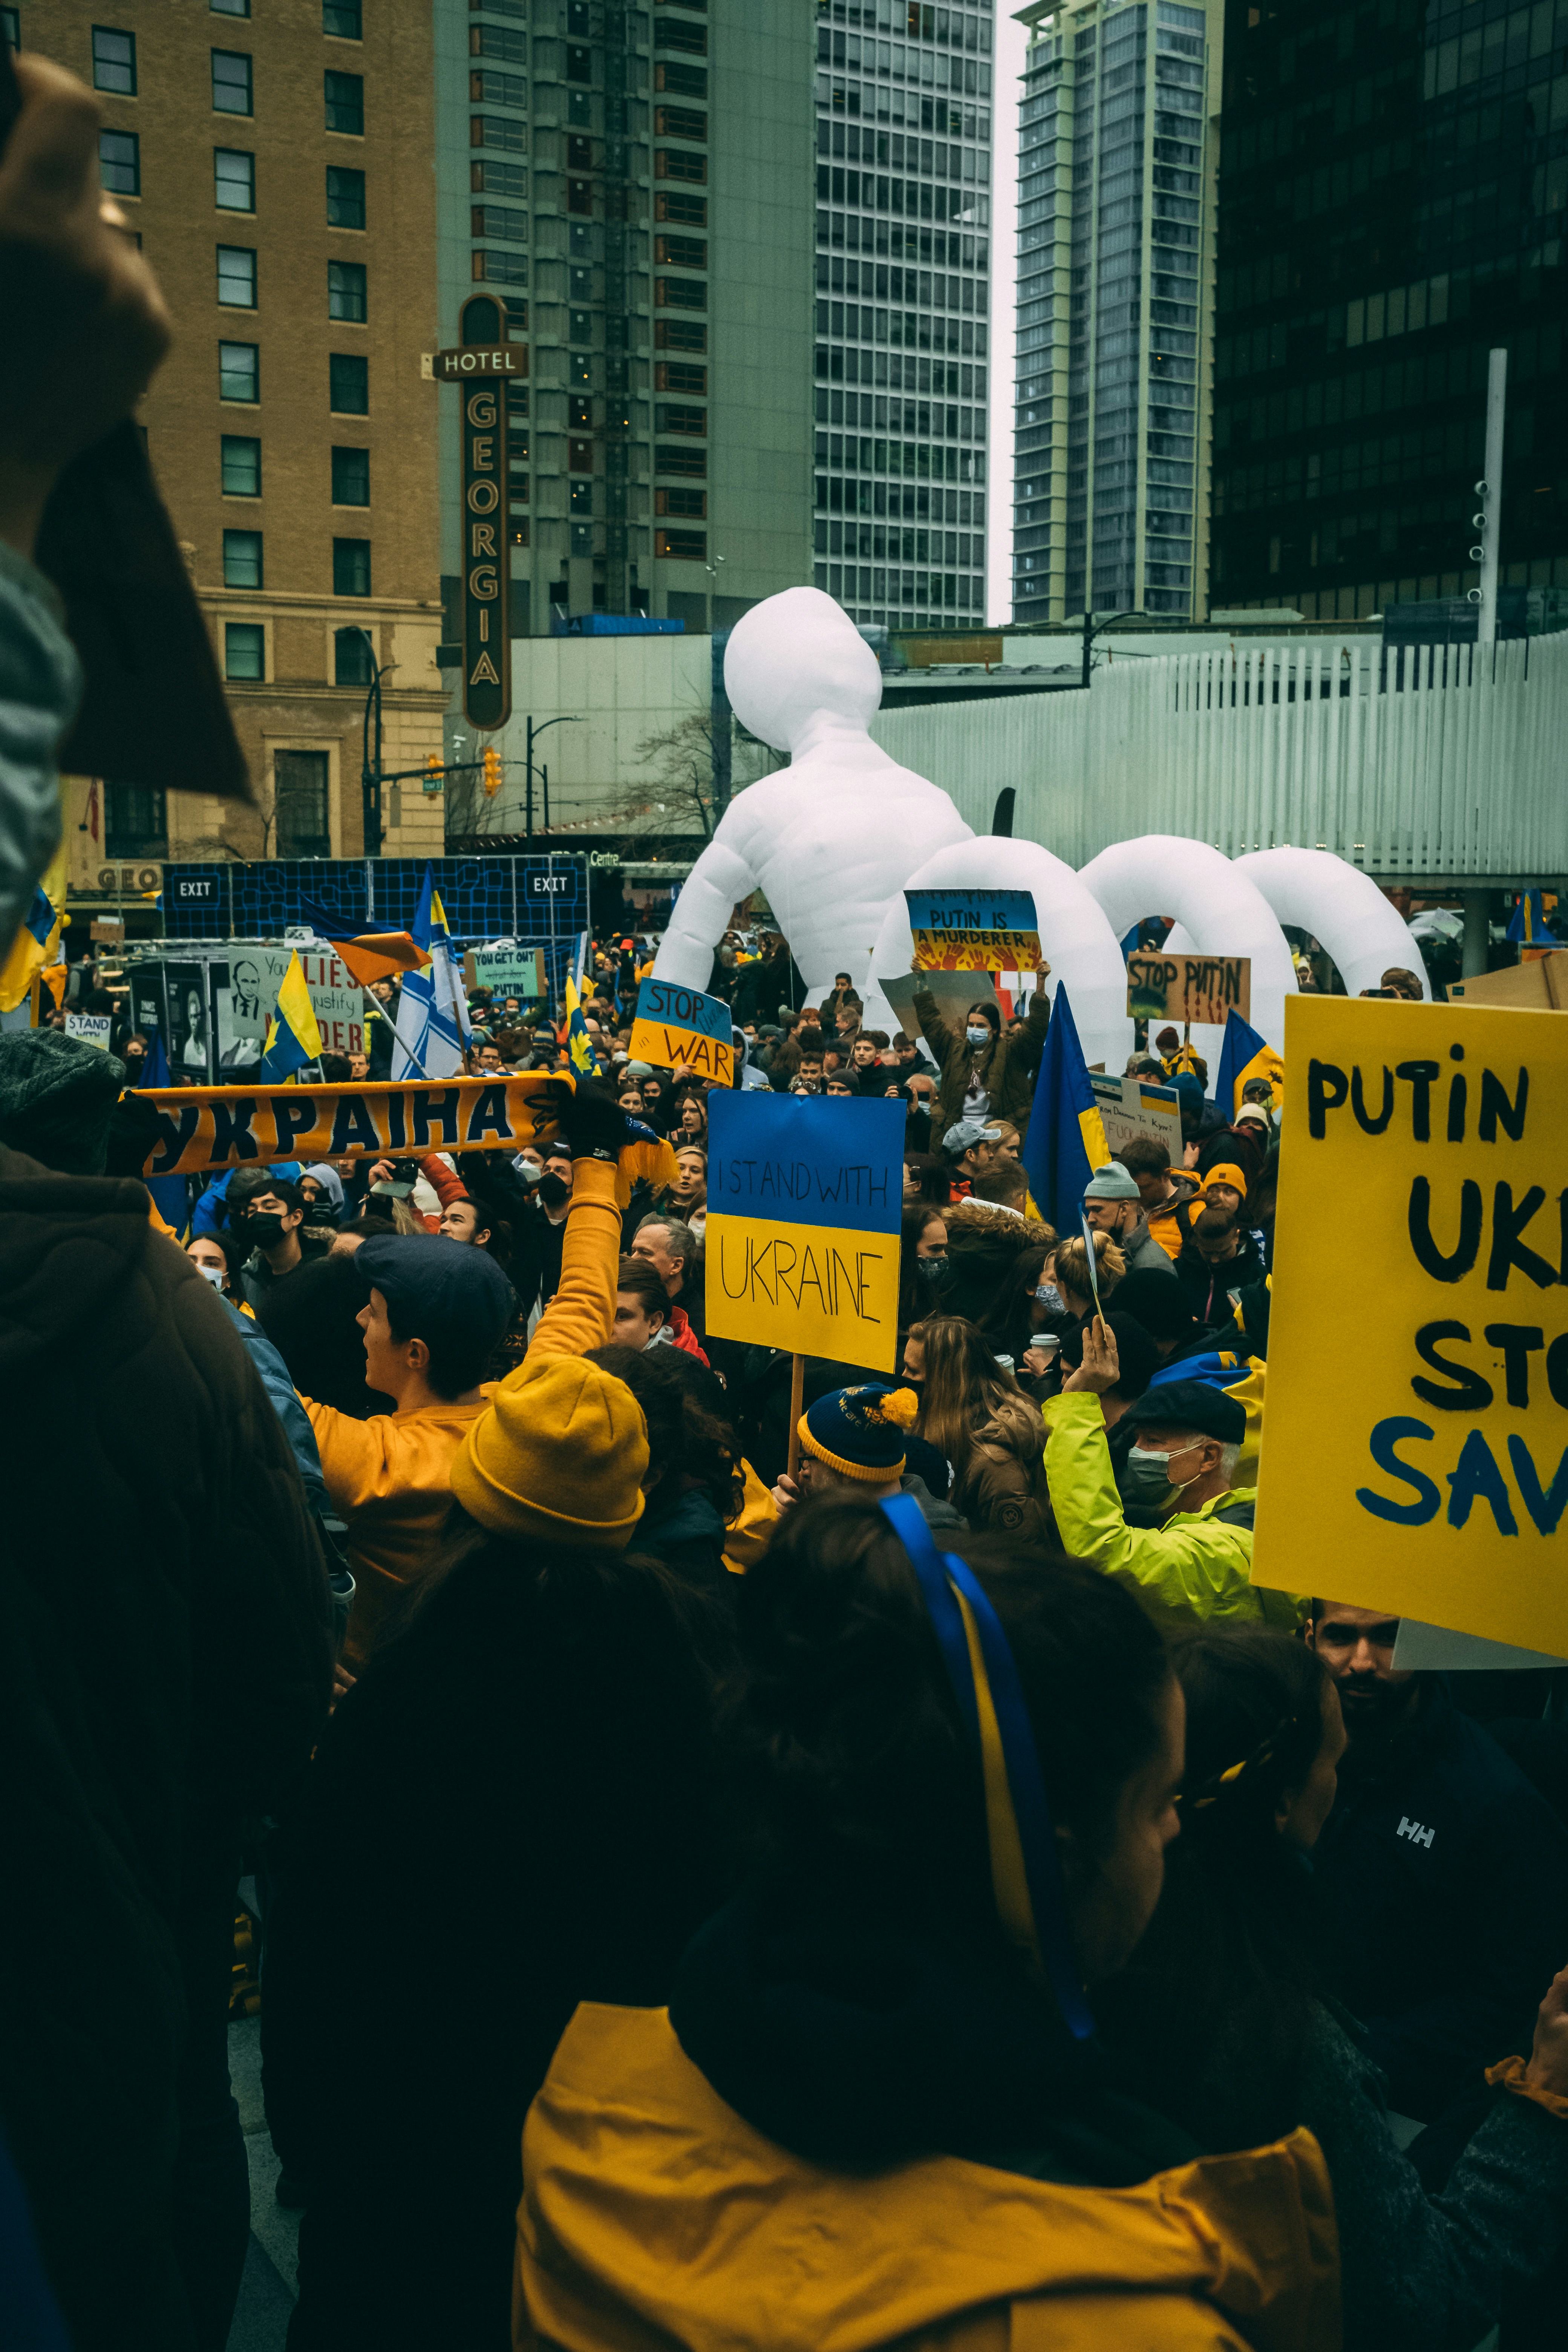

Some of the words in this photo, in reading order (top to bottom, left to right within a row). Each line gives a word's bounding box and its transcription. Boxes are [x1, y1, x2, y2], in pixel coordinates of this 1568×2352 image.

[445, 352, 516, 372] HOTEL
[467, 392, 500, 686] GEORGIA
[590, 850, 619, 866] Centre
[180, 882, 211, 896] EXIT
[534, 877, 567, 891] EXIT
[930, 909, 980, 928] PUTIN
[992, 911, 1008, 930] IS
[918, 929, 929, 942] A
[933, 929, 1027, 948] MURDERER
[476, 953, 493, 965] YOU
[495, 952, 514, 965] GET
[516, 951, 534, 963] OUT
[1128, 958, 1178, 994] STOP
[493, 983, 524, 996] PUTIN
[312, 991, 355, 1018] justify
[647, 986, 704, 1024] STOP
[69, 1017, 109, 1030] STAND
[664, 1029, 730, 1081] WAR
[718, 1159, 722, 1191] I
[729, 1160, 811, 1200] STAND
[815, 1165, 888, 1208] WITH
[1408, 1175, 1568, 1292] UK
[720, 1235, 883, 1324] UKRAINE
[1396, 1816, 1435, 1848] HH
